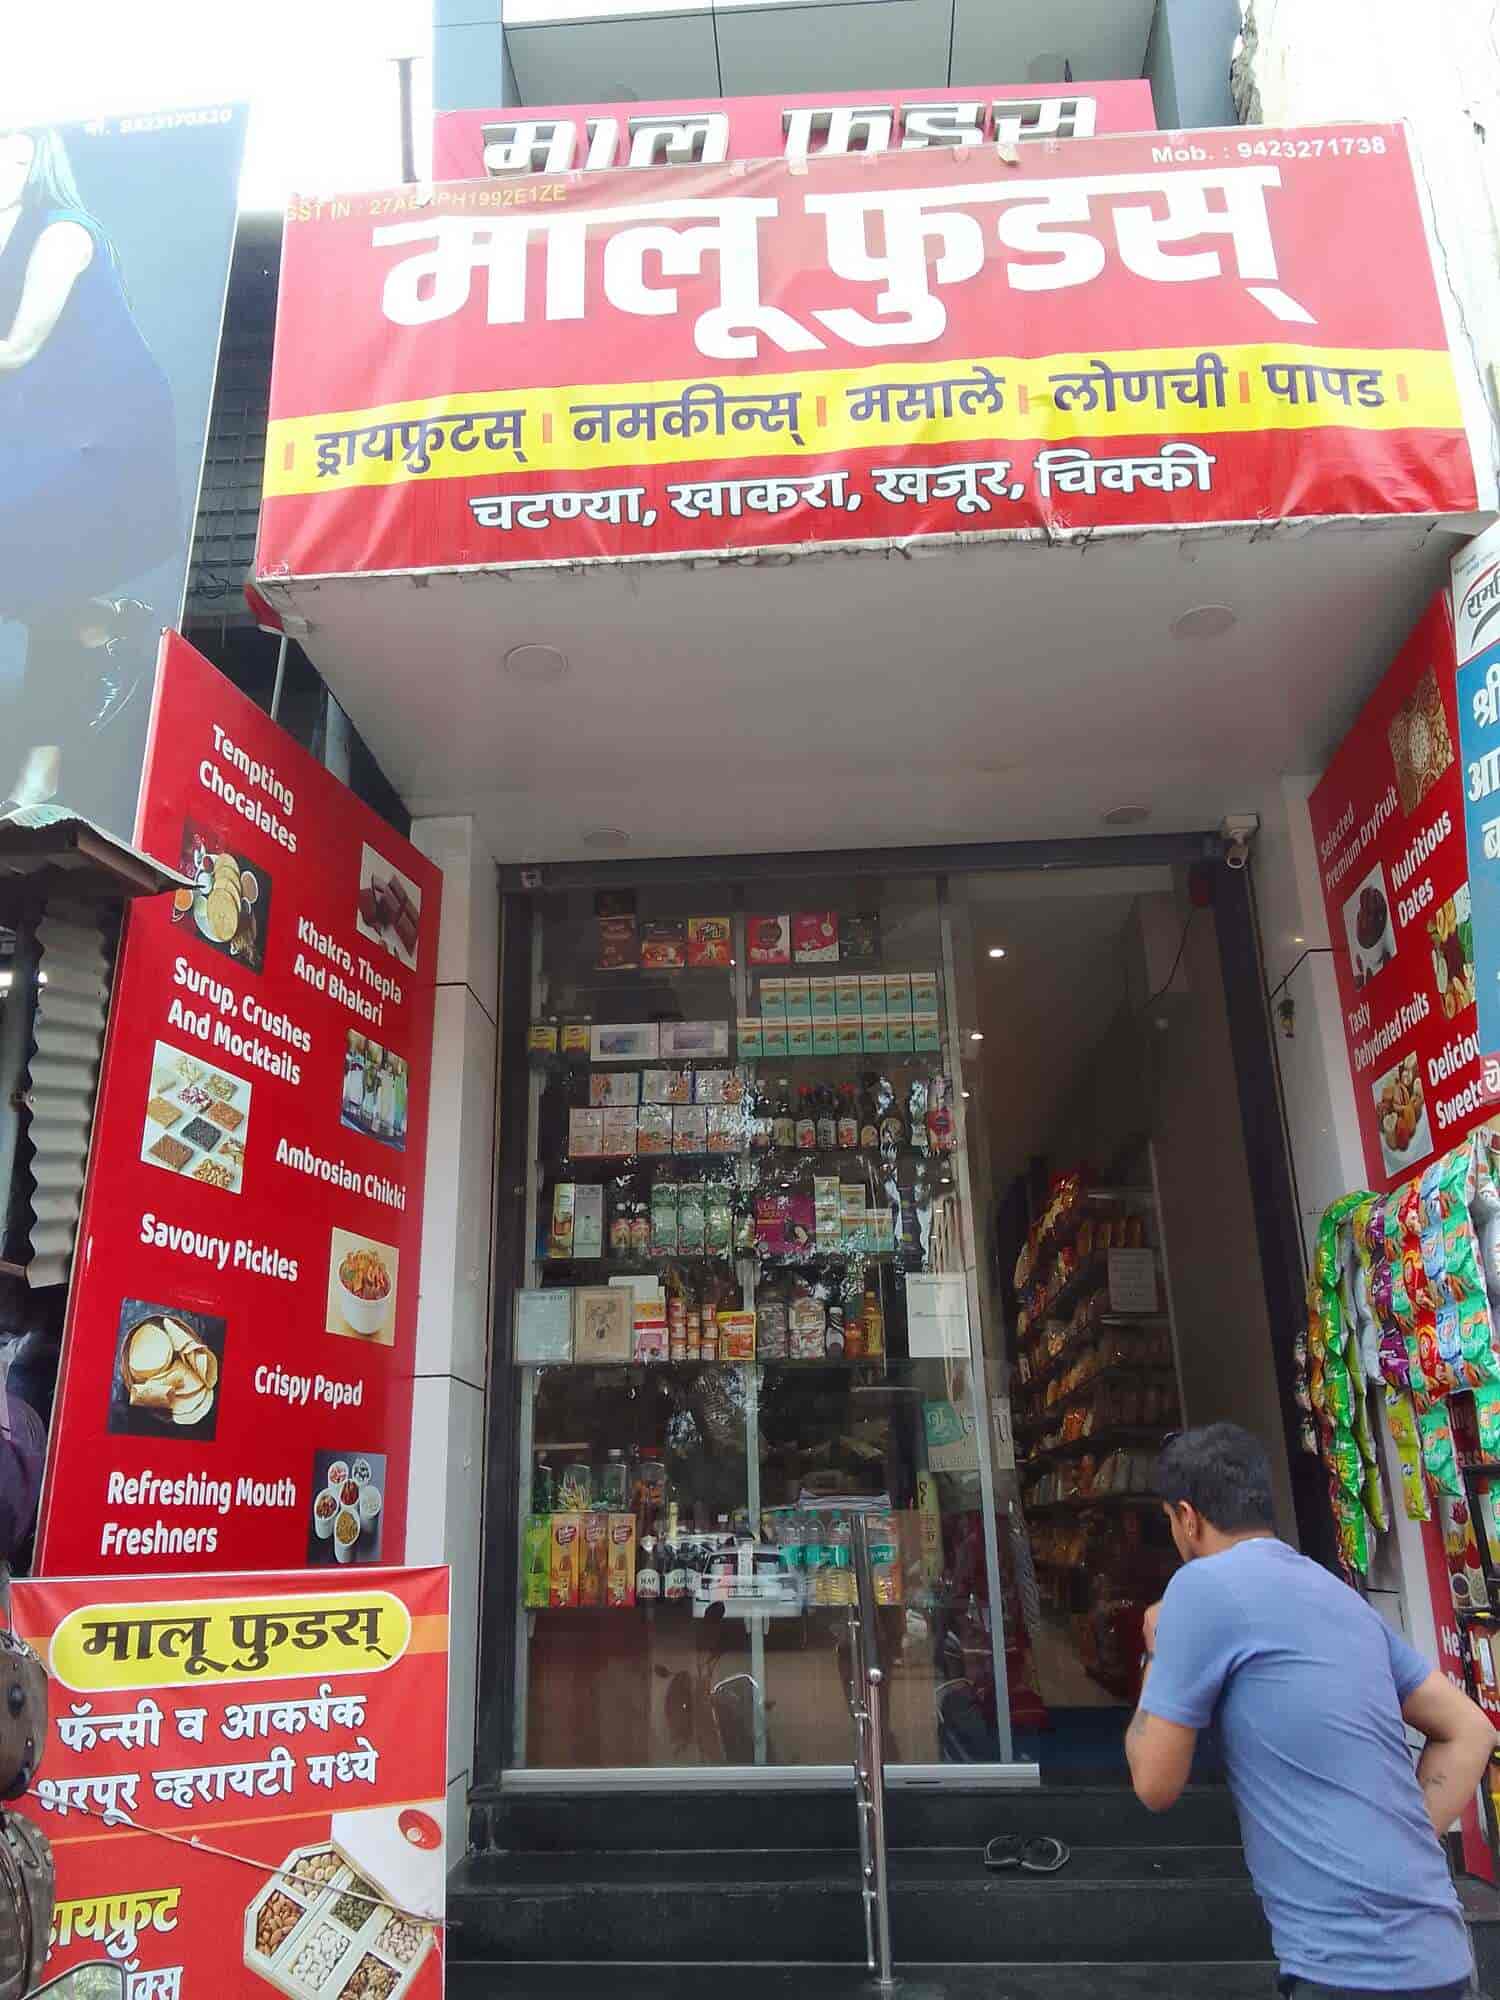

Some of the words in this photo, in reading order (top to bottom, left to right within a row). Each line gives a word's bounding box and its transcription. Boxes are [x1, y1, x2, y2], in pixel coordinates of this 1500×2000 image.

[1152, 145, 1214, 163] Mob.
[1236, 136, 1387, 159] 9423271738
[371, 196, 826, 360] मालू
[804, 165, 1318, 349] फुडस्
[314, 408, 528, 478] ड्रायफ्रुटस्
[569, 383, 806, 447] नमकीन्स्
[845, 366, 1006, 424] मसाले
[1048, 352, 1229, 413] लोणची
[1261, 362, 1385, 408] पापड
[469, 486, 658, 531] चटण्या,
[665, 471, 862, 518] खाकरा,
[870, 460, 1026, 514] खजूर,
[1033, 442, 1217, 497] चिक्की
[198, 760, 298, 854] Chocalates
[211, 723, 295, 816] Tempting
[1360, 784, 1399, 848] Dryfruit
[1391, 809, 1452, 893] Nutritious
[1398, 876, 1434, 929] Dates
[293, 953, 326, 991] And
[328, 974, 384, 1027] Bhakari
[297, 915, 356, 978] Khakra,
[357, 957, 402, 1004] Thepla
[173, 956, 238, 1017] Surup,
[242, 995, 312, 1053] Crushes
[1354, 1008, 1401, 1073] Dehydrated
[1400, 991, 1430, 1033] Fruits
[167, 999, 210, 1041] And
[213, 1021, 301, 1086] Mocktails
[1427, 1030, 1480, 1087] Deliciou
[276, 1137, 361, 1194] Ambrosian
[364, 1174, 407, 1212] Chikki
[140, 1212, 230, 1270] Savoury
[233, 1239, 298, 1283] Pickles
[254, 1365, 311, 1406] Crispy
[313, 1374, 363, 1410] Papad
[107, 1471, 233, 1514] Refreshing
[235, 1476, 296, 1508] Mouth
[100, 1520, 218, 1556] Freshners
[81, 1616, 228, 1675] मालू
[228, 1607, 392, 1672] फुडस्
[57, 1697, 164, 1752] फॅन्सी
[175, 1708, 208, 1744] व
[220, 1684, 368, 1741] आकर्षक
[36, 1773, 140, 1828] भरपूर
[152, 1746, 296, 1808] व्हरायटी
[305, 1737, 380, 1788] मध्ये
